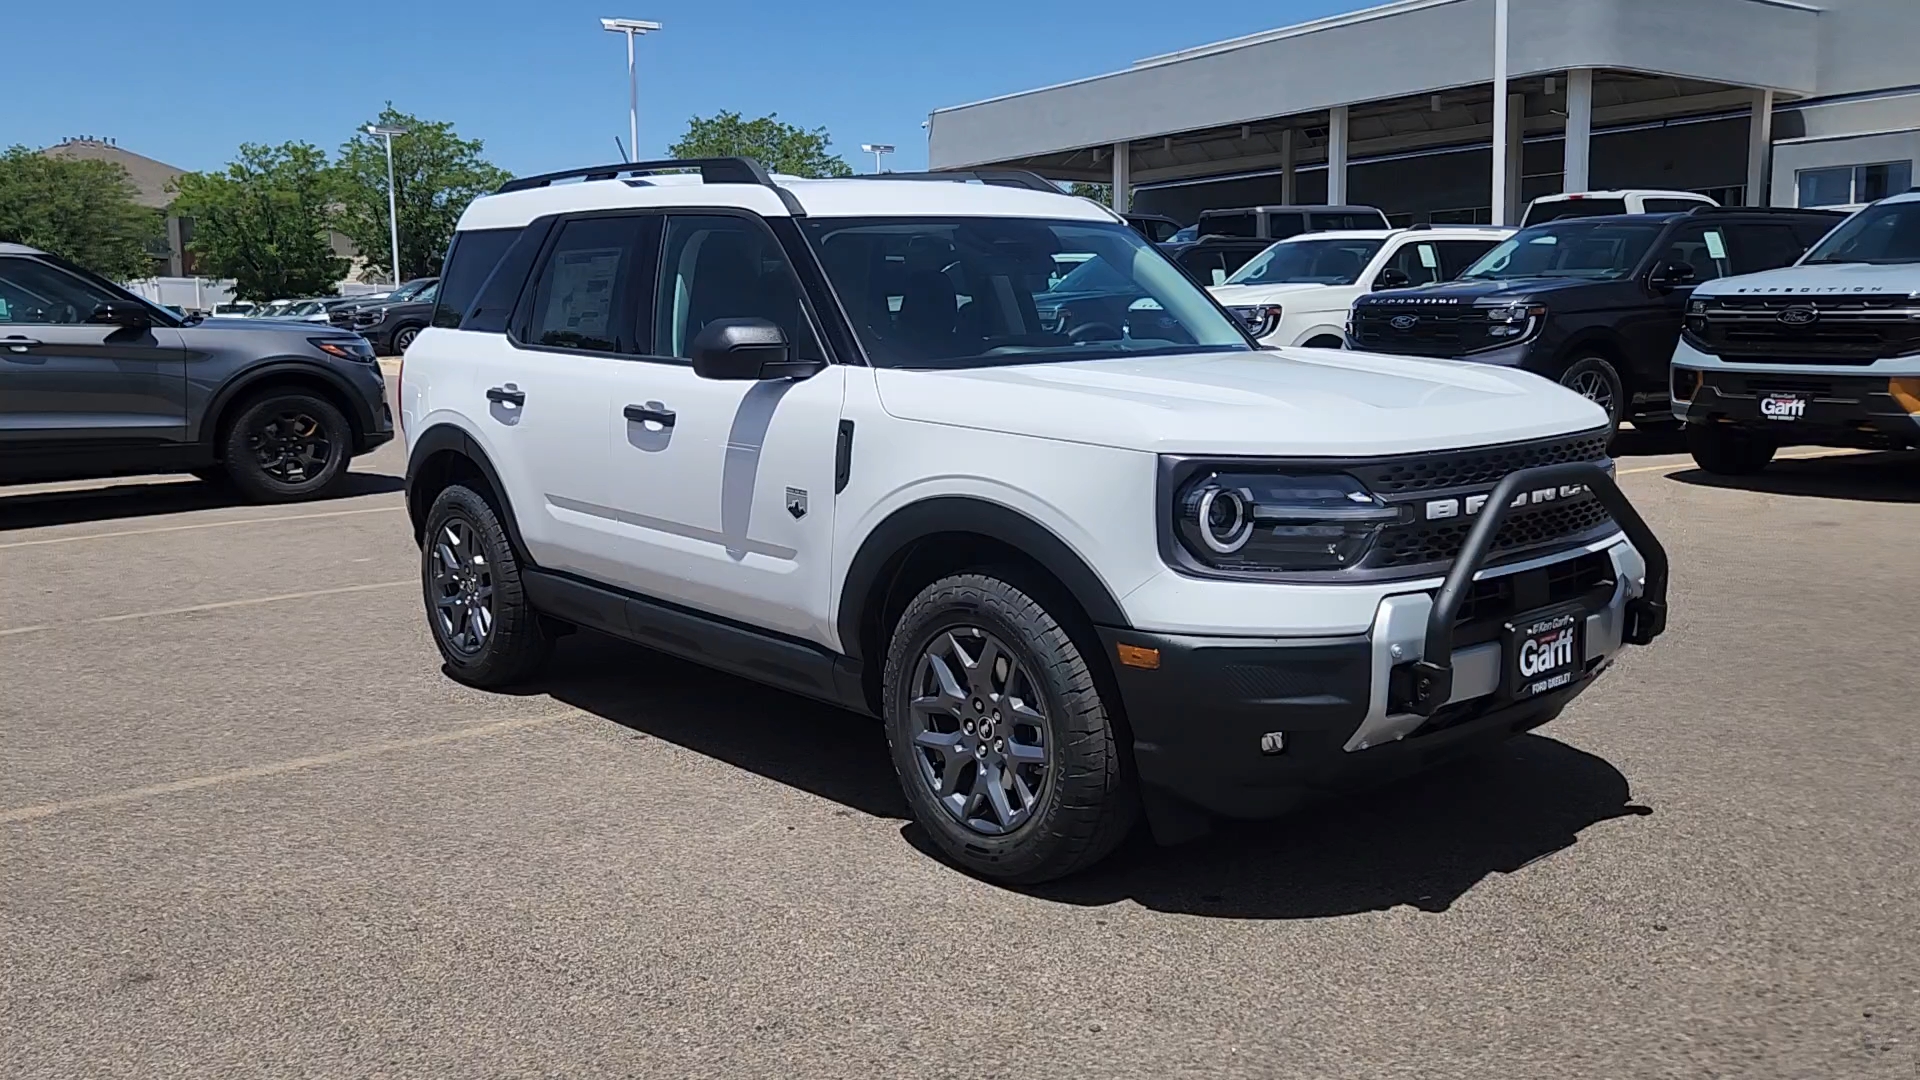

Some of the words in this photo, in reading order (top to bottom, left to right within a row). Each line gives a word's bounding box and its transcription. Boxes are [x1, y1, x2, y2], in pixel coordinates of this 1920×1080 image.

[1760, 398, 1806, 416] Garff
[1426, 484, 1592, 520] BRNC
[1519, 627, 1574, 677] Garff
[1532, 680, 1547, 695] FORD
